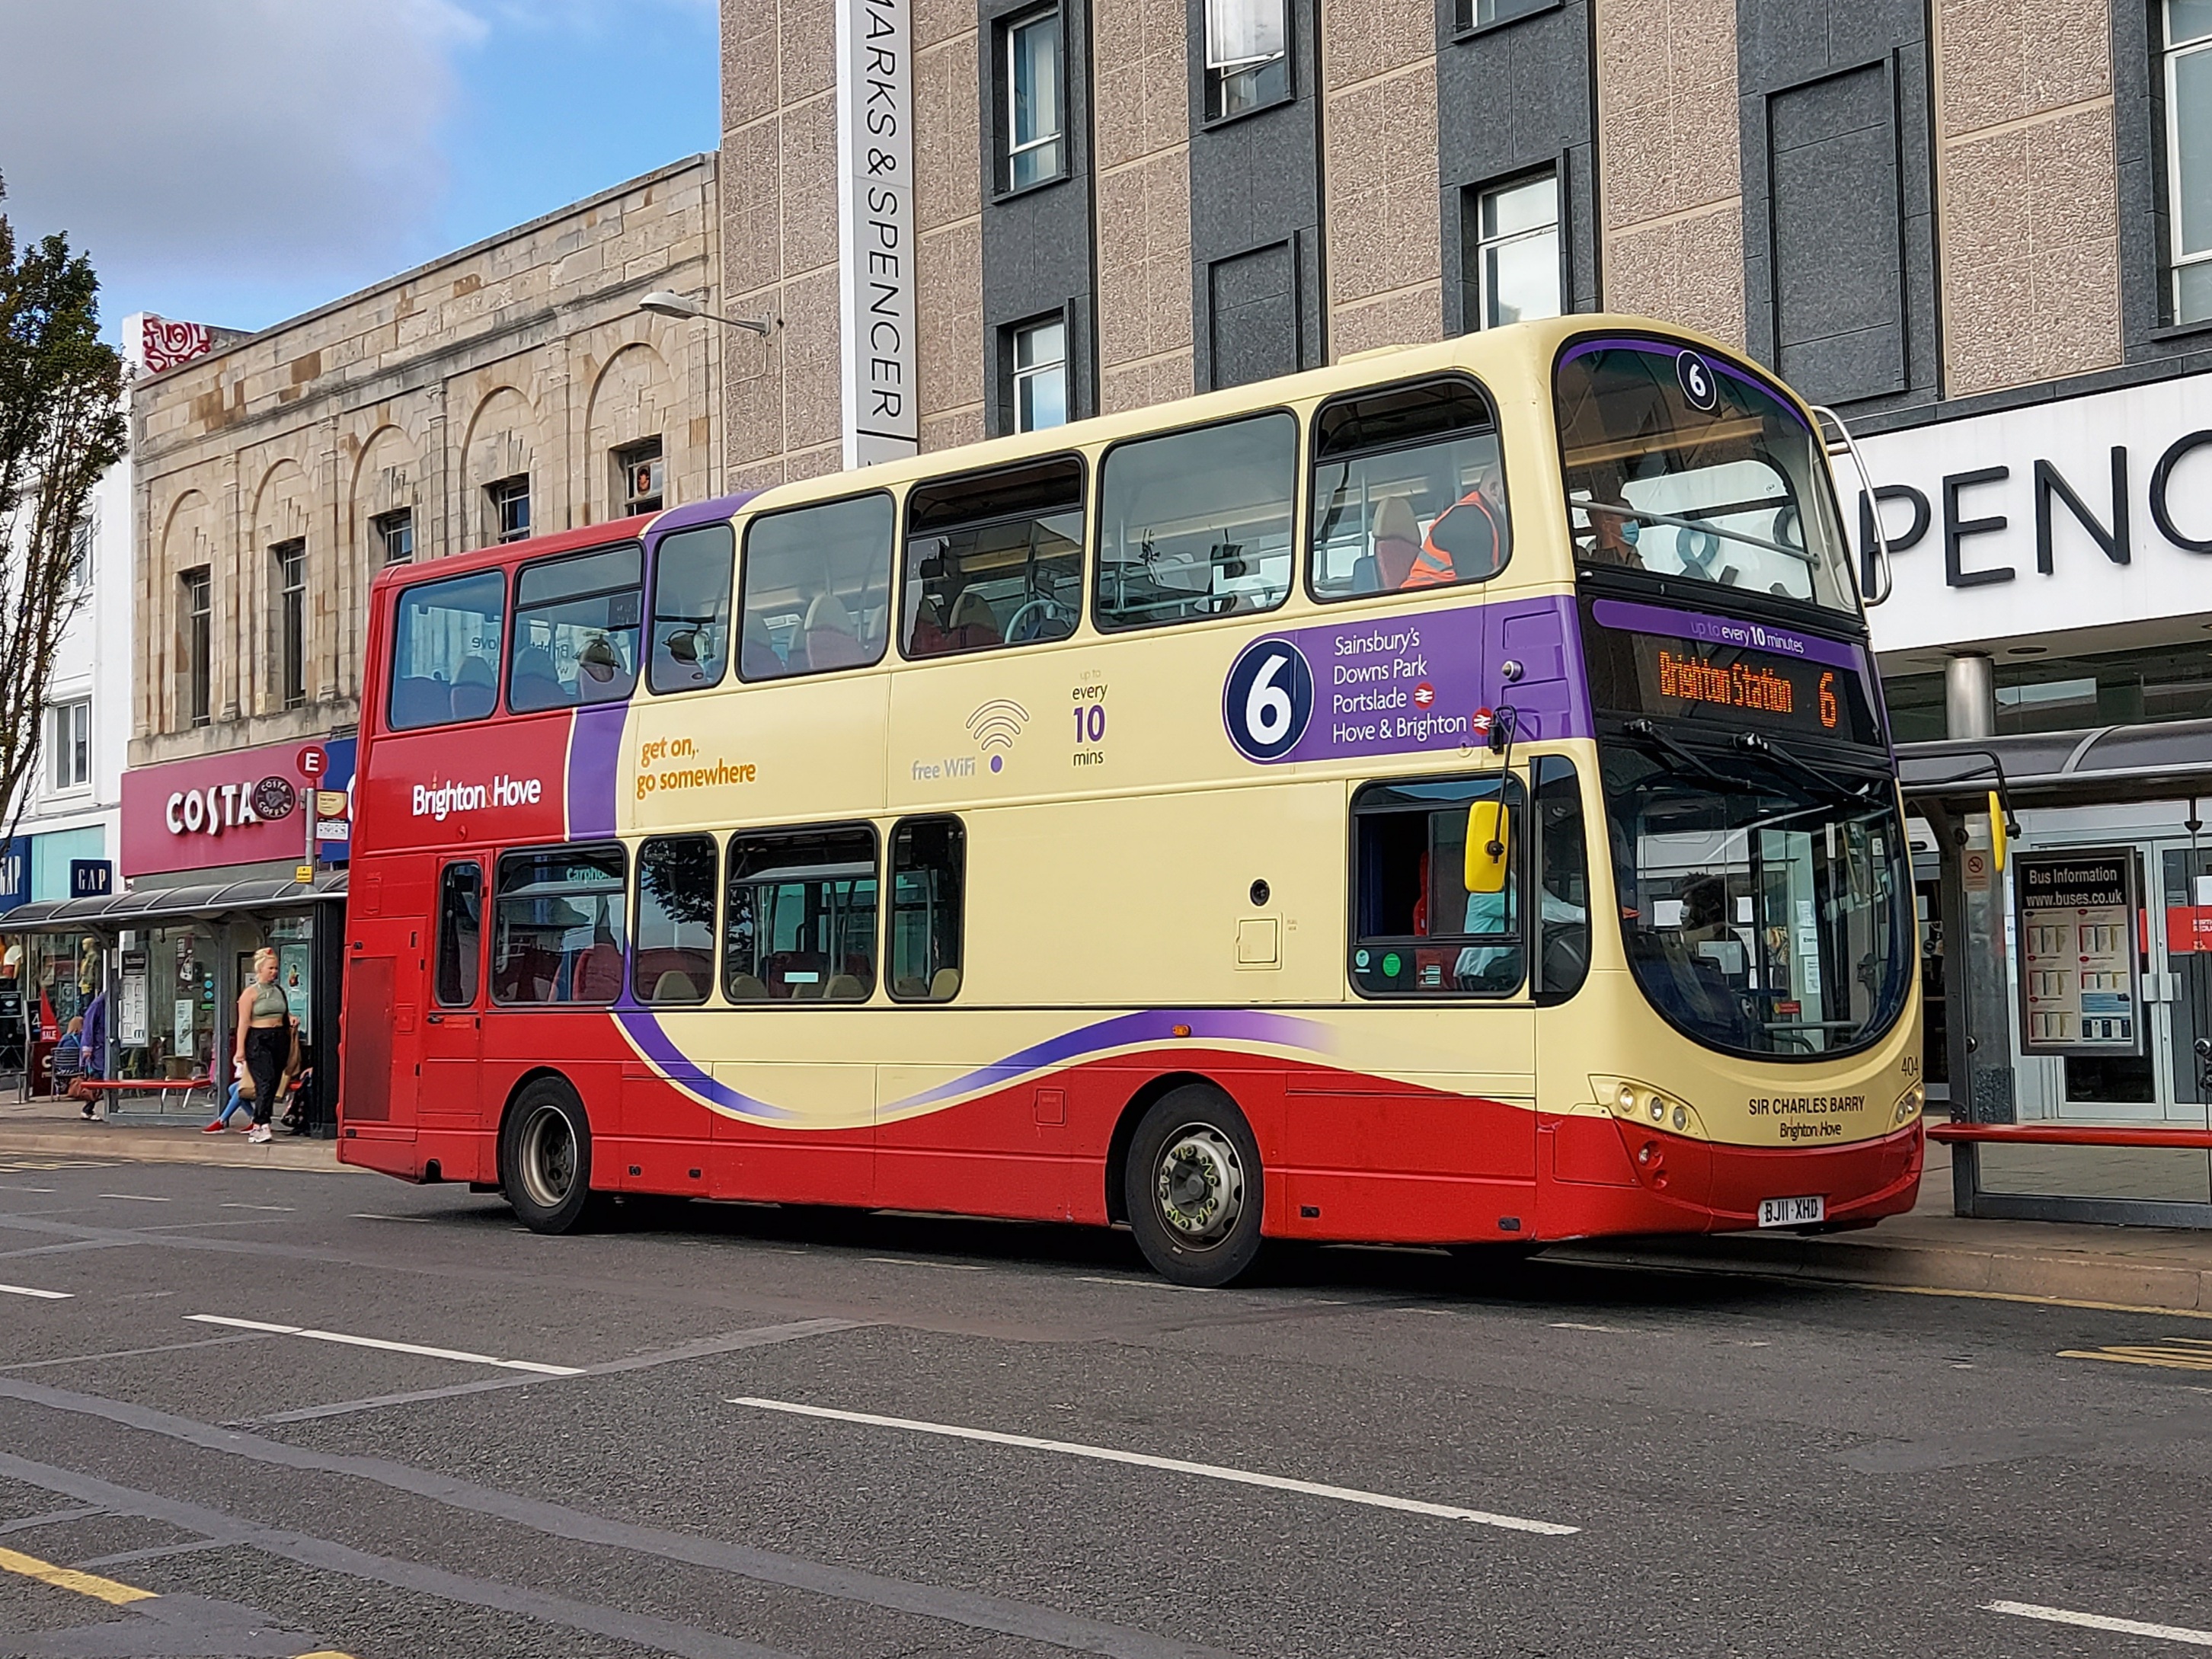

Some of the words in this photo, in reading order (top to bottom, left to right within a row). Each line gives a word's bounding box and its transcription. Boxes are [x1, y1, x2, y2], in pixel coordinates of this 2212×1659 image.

[867, 148, 897, 176] &
[868, 186, 901, 418] SPENCER
[1689, 363, 1706, 397] 6
[1334, 627, 1421, 657] Sainsbury's
[1721, 626, 1750, 647] every
[1750, 625, 1766, 647] 10
[1766, 633, 1804, 654] minutes
[1334, 664, 1389, 686] Downs
[1392, 654, 1427, 679] Park
[1660, 650, 1731, 705] Brighton
[1732, 662, 1793, 713] Station
[1072, 684, 1108, 702] every
[1245, 654, 1292, 745] 6
[1333, 686, 1408, 714] Portslade
[1819, 671, 1837, 729] 6
[1072, 704, 1106, 743] 10
[1333, 722, 1376, 744] Hove
[1379, 718, 1393, 739] &
[1396, 712, 1467, 742] Brighton
[305, 752, 320, 772] E
[641, 736, 667, 768] get
[1072, 747, 1104, 766] mins
[636, 773, 656, 801] go
[660, 757, 756, 791] somewhere
[913, 759, 941, 781] free
[943, 756, 977, 778] WiFi
[261, 780, 288, 792] COSTA
[494, 774, 542, 807] Hove
[165, 781, 259, 836] COSTA
[258, 801, 291, 816] COFFEE
[78, 868, 107, 890] GAP
[2028, 869, 2051, 884] Bus
[2054, 865, 2118, 884] Information
[2025, 888, 2123, 907] www.buses.co.uk
[1900, 1056, 1919, 1077] 404
[1749, 1098, 1769, 1115] SIR
[1772, 1097, 1827, 1115] CHARLES
[1830, 1095, 1865, 1113] BARRY
[1779, 1121, 1818, 1142] Brighton
[1820, 1120, 1842, 1137] Hove
[1765, 1200, 1789, 1223] BJ11
[1795, 1198, 1819, 1219] XHD
